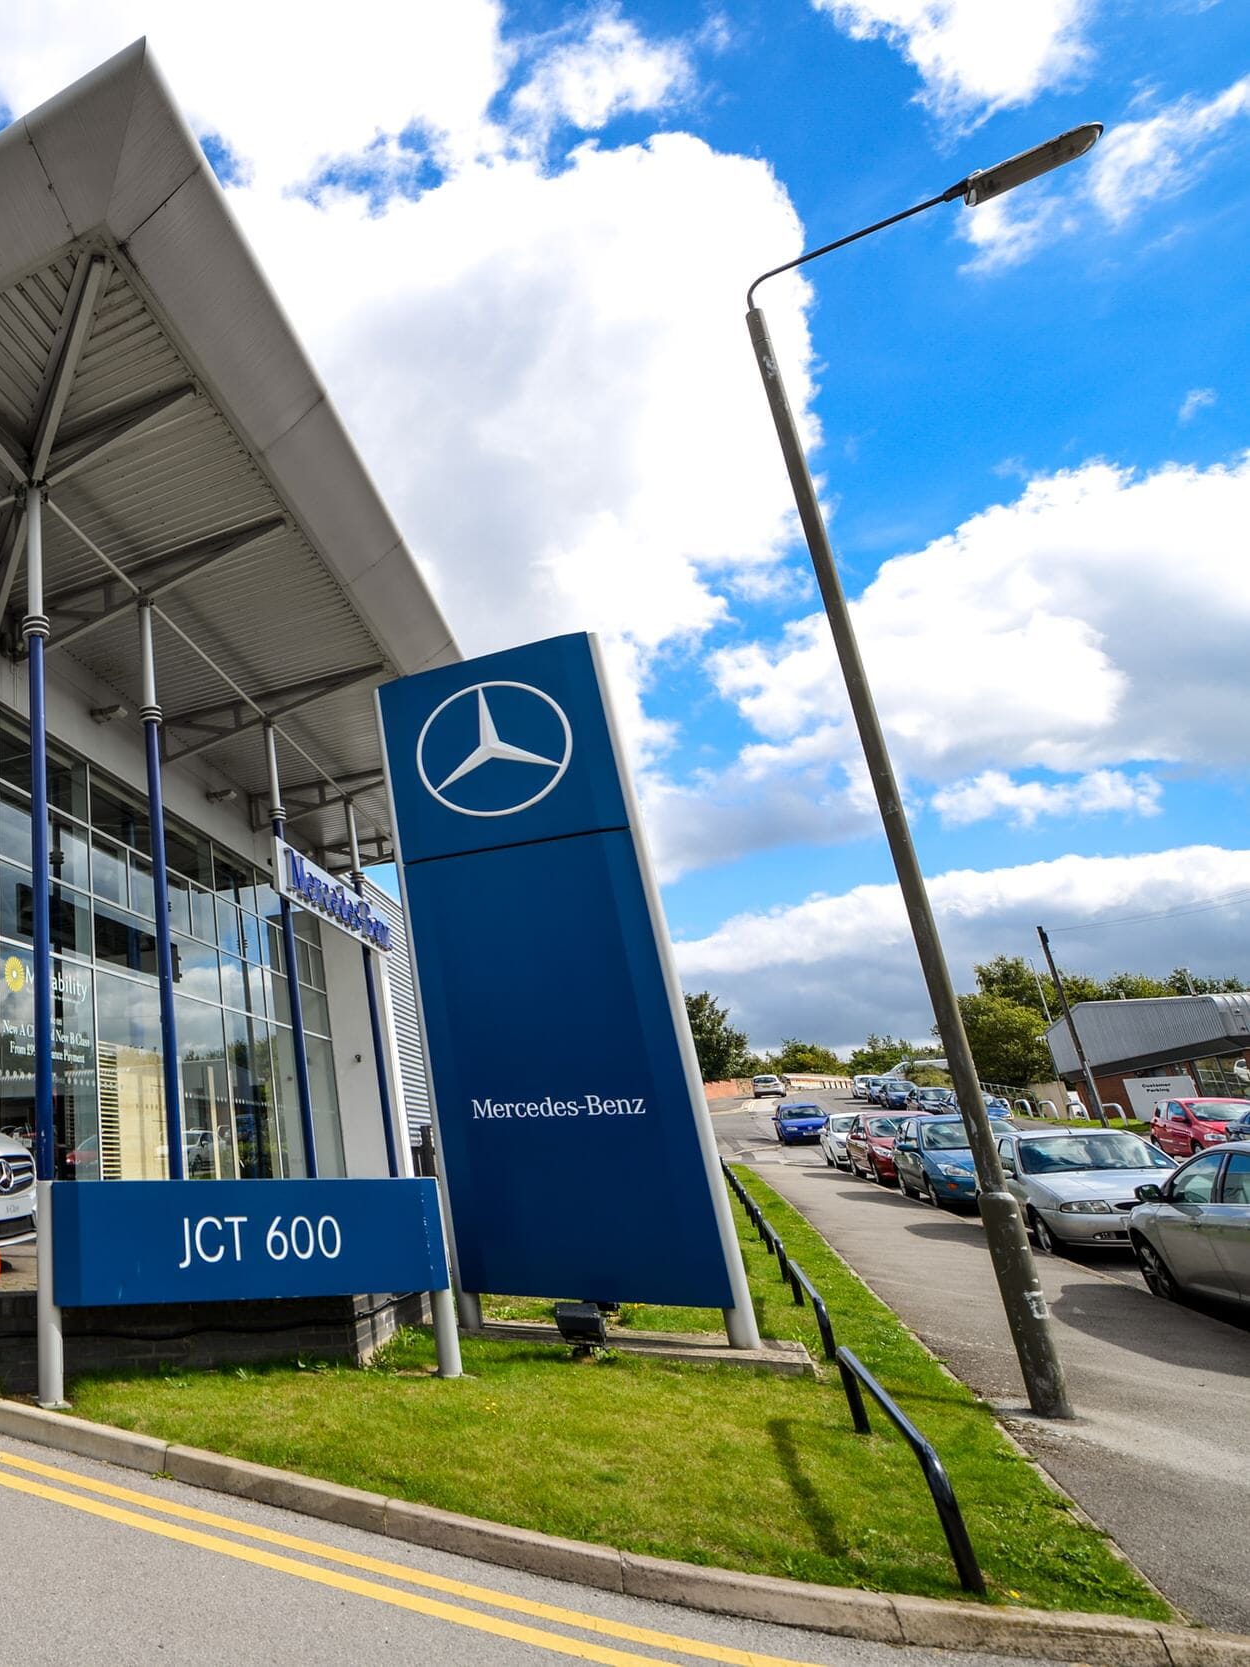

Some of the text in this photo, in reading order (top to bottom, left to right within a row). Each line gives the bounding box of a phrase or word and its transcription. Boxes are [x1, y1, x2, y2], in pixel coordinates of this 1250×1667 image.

[284, 848, 392, 951] Mercedes-Benz
[26, 965, 87, 1002] Mability
[3, 1019, 19, 1035] New
[20, 1024, 26, 1036] A
[56, 1029, 69, 1043] New
[70, 1032, 75, 1045] B
[75, 1033, 90, 1047] Class
[10, 1040, 26, 1055] From
[471, 1095, 646, 1120] Mercedes-Benz
[179, 1215, 342, 1269] JCT 600
